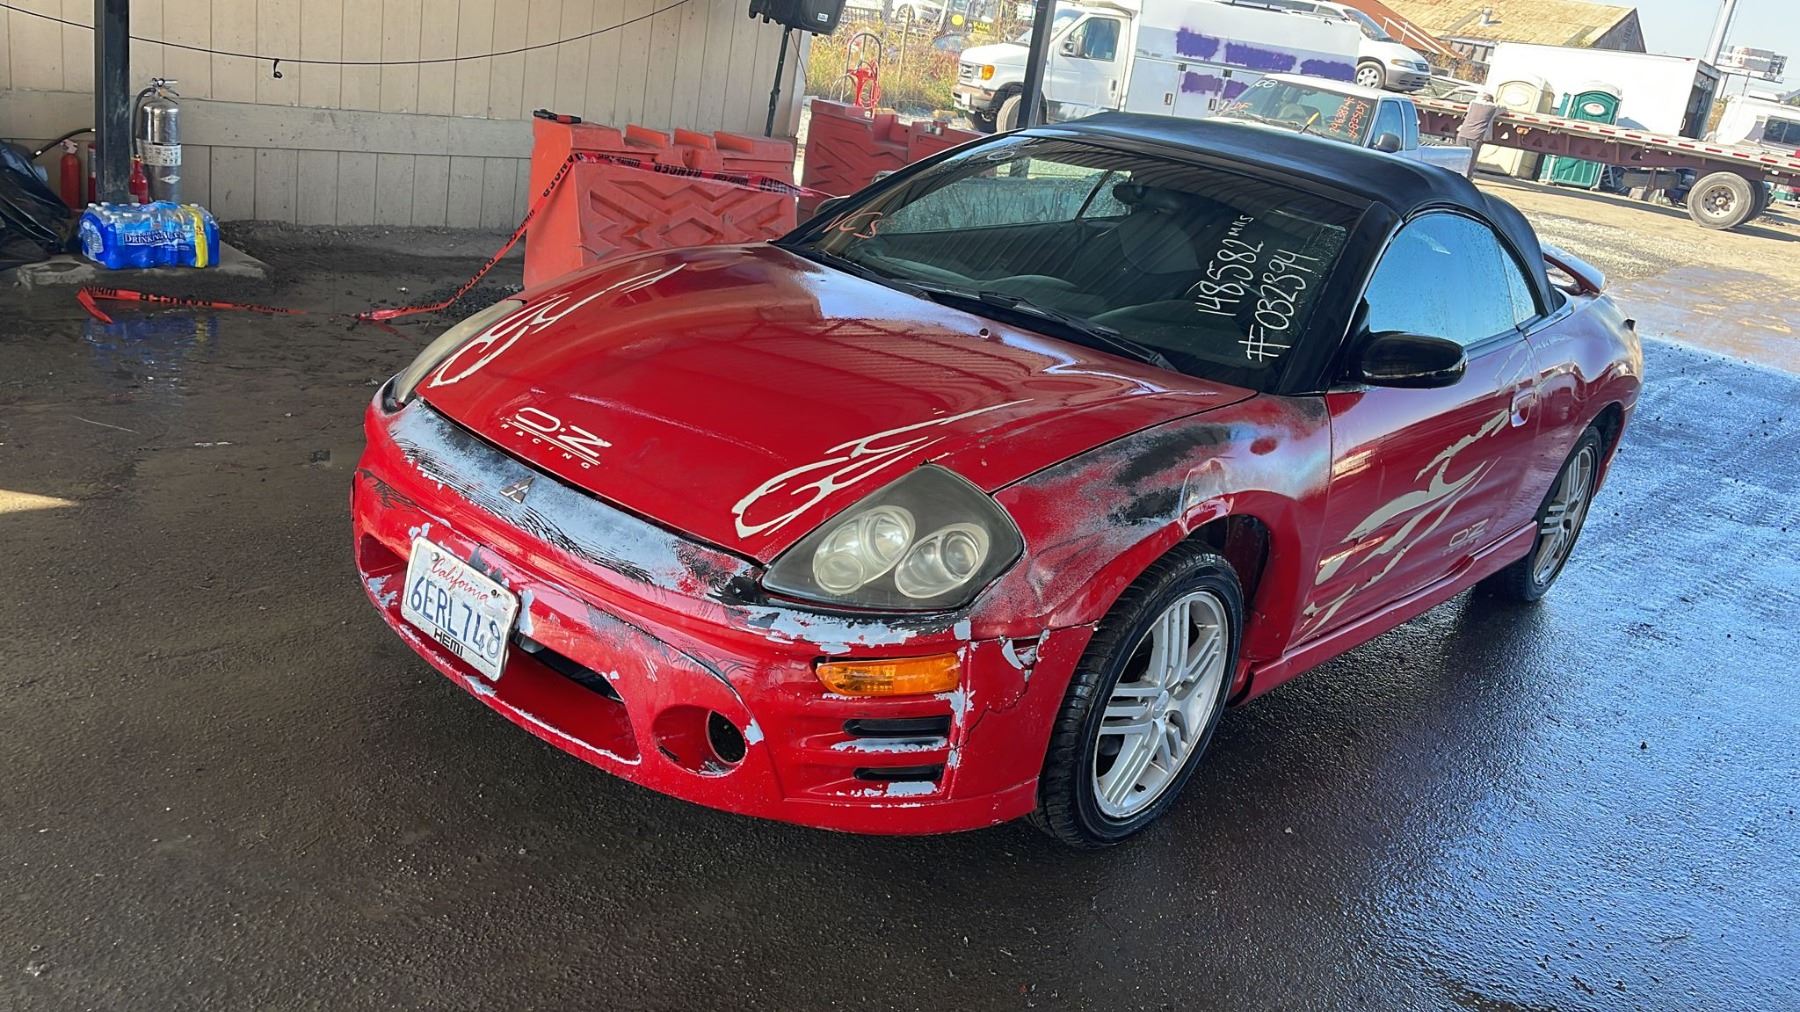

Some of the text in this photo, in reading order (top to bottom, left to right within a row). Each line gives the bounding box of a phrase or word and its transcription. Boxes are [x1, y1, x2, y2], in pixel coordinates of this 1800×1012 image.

[1238, 249, 1319, 363] #032394
[431, 555, 489, 601] California
[410, 575, 501, 659] 6ERL748
[433, 627, 464, 658] HEMI
